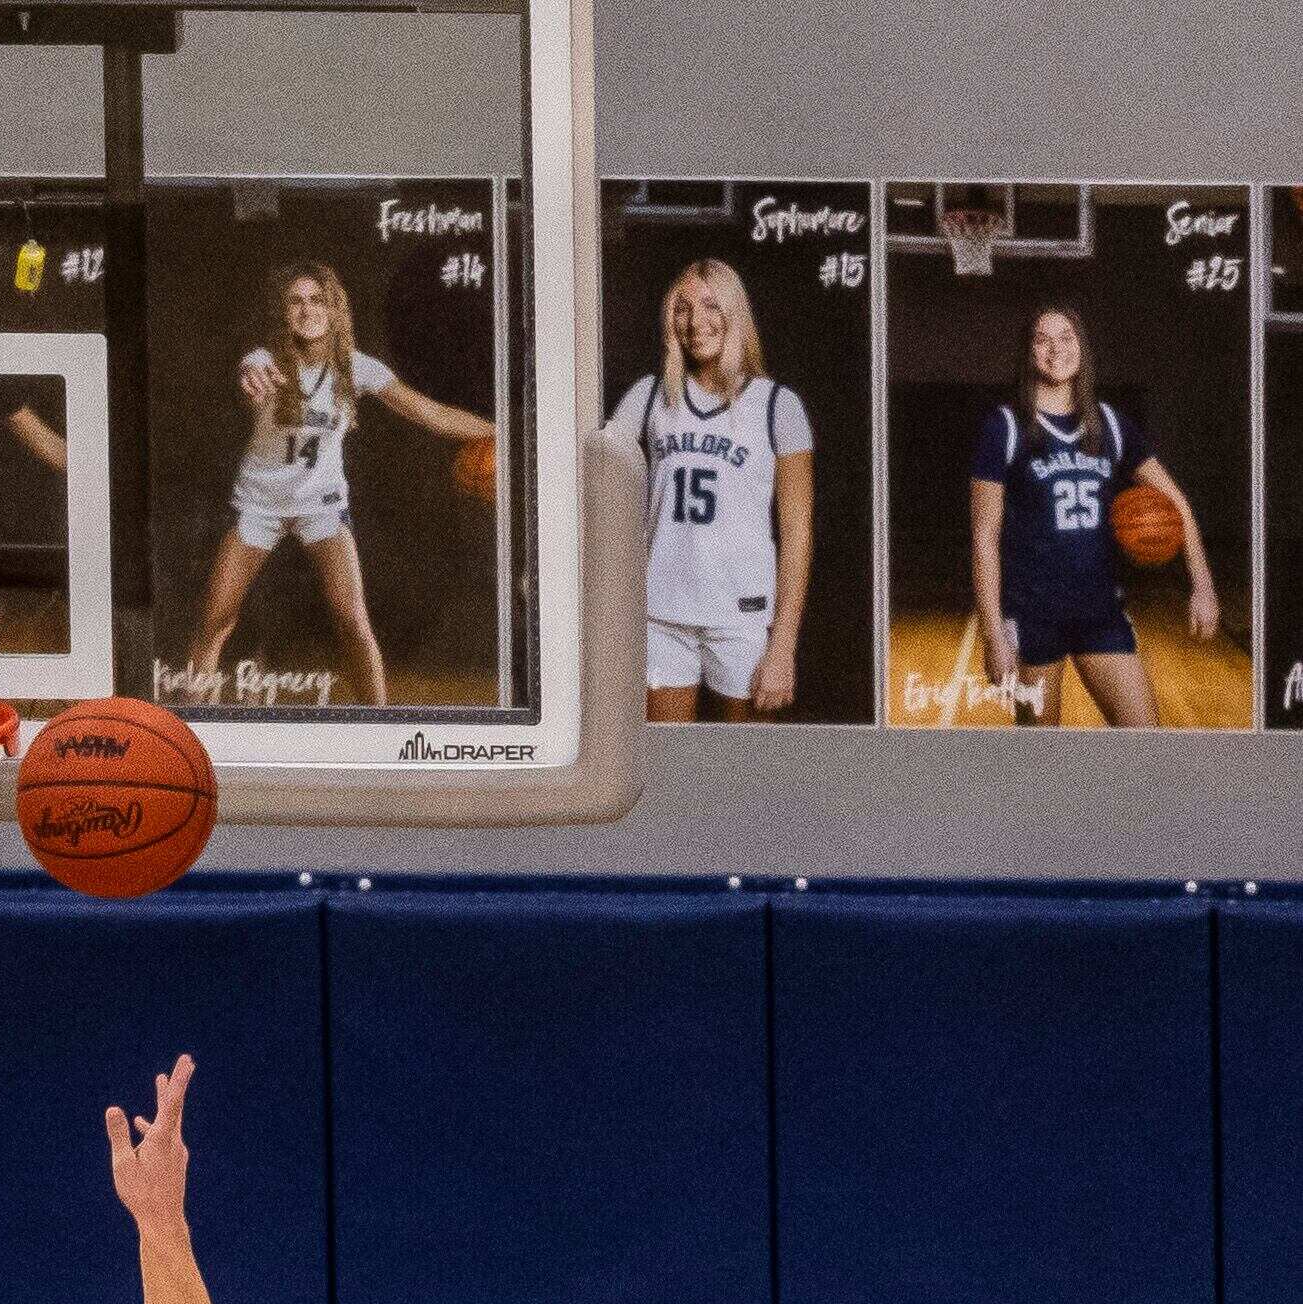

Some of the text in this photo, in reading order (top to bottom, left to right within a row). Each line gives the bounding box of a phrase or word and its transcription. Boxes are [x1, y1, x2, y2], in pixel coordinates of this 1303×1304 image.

[377, 198, 483, 242] Freshman
[751, 196, 865, 244] Sophomore
[1165, 199, 1240, 246] Senior
[818, 252, 868, 288] #15
[672, 466, 718, 525] 15
[1052, 478, 1100, 531] 25
[443, 744, 535, 761] DRAPER
